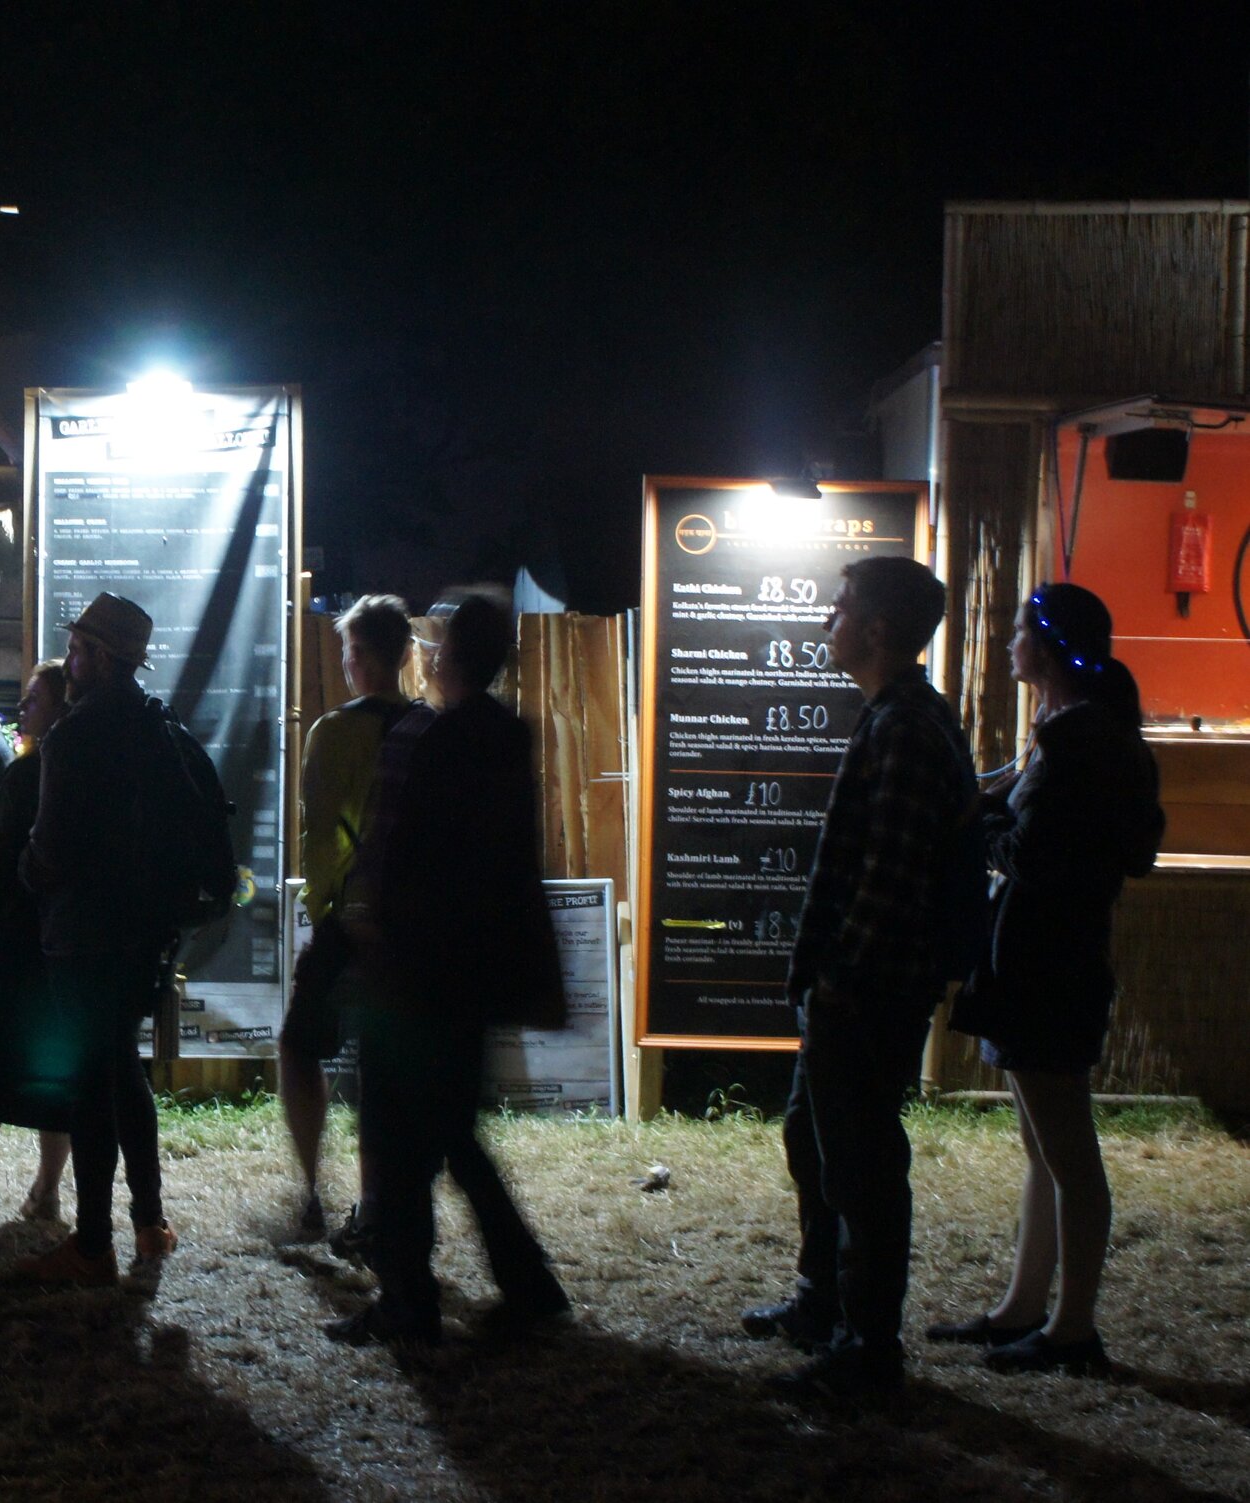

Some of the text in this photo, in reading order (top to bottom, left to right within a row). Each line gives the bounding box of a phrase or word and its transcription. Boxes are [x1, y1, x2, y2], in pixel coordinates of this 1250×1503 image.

[820, 517, 874, 538] raps
[702, 583, 742, 595] Chicken
[758, 576, 818, 604] £8.50
[671, 648, 748, 660] Sharmi Chicken
[766, 639, 830, 669] £8.50
[671, 667, 698, 675] Chicken
[699, 667, 720, 677] thighs
[721, 669, 755, 677] marinated
[778, 679, 812, 687] Garnished
[670, 713, 750, 725] Munnar Chicken
[766, 705, 829, 732] £8.50
[669, 732, 696, 740] Chicken
[698, 732, 718, 742] thighs
[762, 734, 779, 742] fresh
[669, 740, 686, 748] fresh
[687, 741, 714, 749] seasonal
[668, 787, 730, 799] Spicy Afghan
[744, 781, 781, 807] £10
[667, 853, 740, 864] Kashmiri Lamb
[565, 895, 598, 906] PROFIT
[728, 919, 743, 931] (v)
